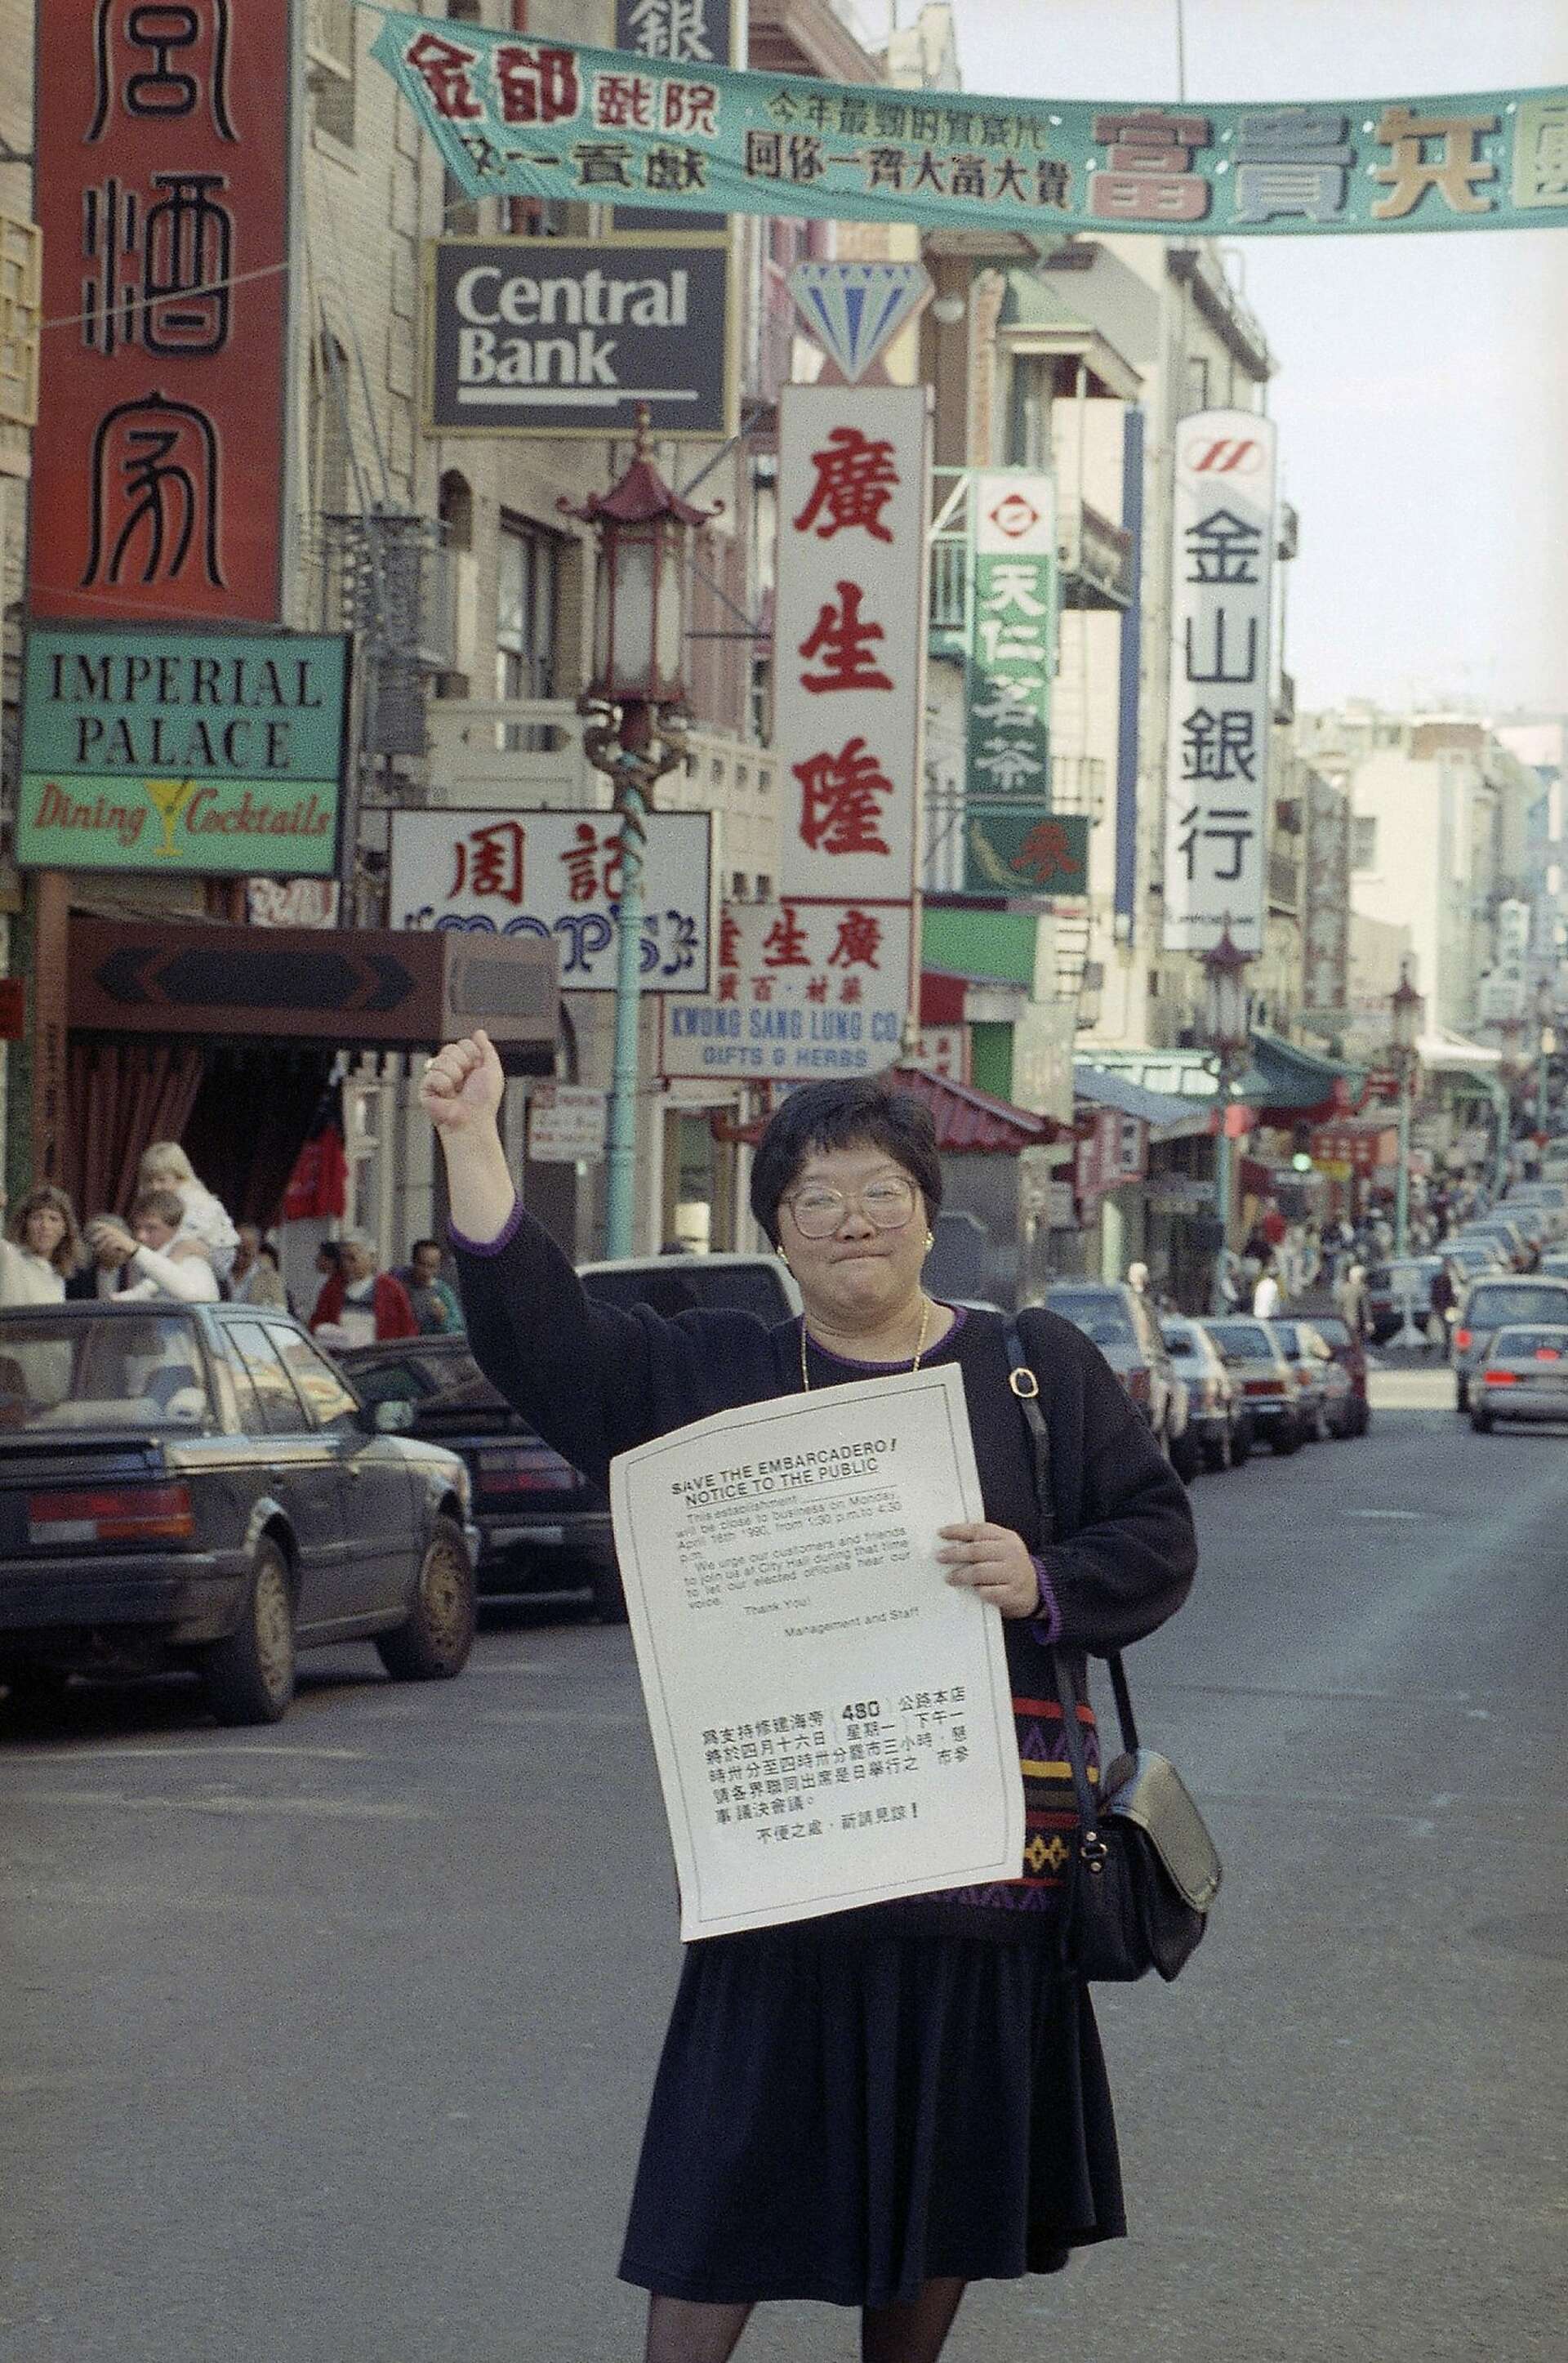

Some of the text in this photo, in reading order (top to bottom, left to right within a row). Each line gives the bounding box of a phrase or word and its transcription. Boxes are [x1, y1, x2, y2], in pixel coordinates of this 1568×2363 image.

[455, 266, 689, 326] Central
[457, 328, 619, 385] Bank
[794, 427, 900, 855] 廣生隆
[51, 654, 322, 708] IMPERIAL
[1178, 508, 1262, 881] 金山銀行
[74, 717, 291, 769] PALACE
[33, 782, 331, 847] Dining Cocktails
[671, 1474, 715, 1495] SAVE
[720, 1465, 753, 1482] THE
[685, 1457, 879, 1508] NOTICE TO THE PUBLIC
[687, 1496, 796, 1523] This establishment
[701, 1524, 715, 1533] be
[720, 1518, 751, 1530] close
[756, 1514, 767, 1523] to
[772, 1505, 825, 1520] business
[831, 1501, 845, 1510] on
[678, 1537, 705, 1549] April
[776, 1521, 802, 1531] from
[695, 1527, 906, 1572] We urge our customers and friends
[684, 1577, 696, 1585] to
[701, 1573, 722, 1585] join
[726, 1570, 740, 1579] us
[759, 1563, 782, 1573] City
[786, 1557, 808, 1567] Hall
[813, 1550, 851, 1563] during
[855, 1545, 878, 1555] that
[882, 1540, 908, 1550] time
[686, 1589, 699, 1598] to
[728, 1581, 746, 1590] our
[754, 1571, 797, 1586] elected
[804, 1559, 851, 1577] officials
[858, 1556, 884, 1567] hear
[891, 1552, 911, 1562] our
[743, 1603, 779, 1615] Thank
[784, 1607, 919, 1637] Management and Staff
